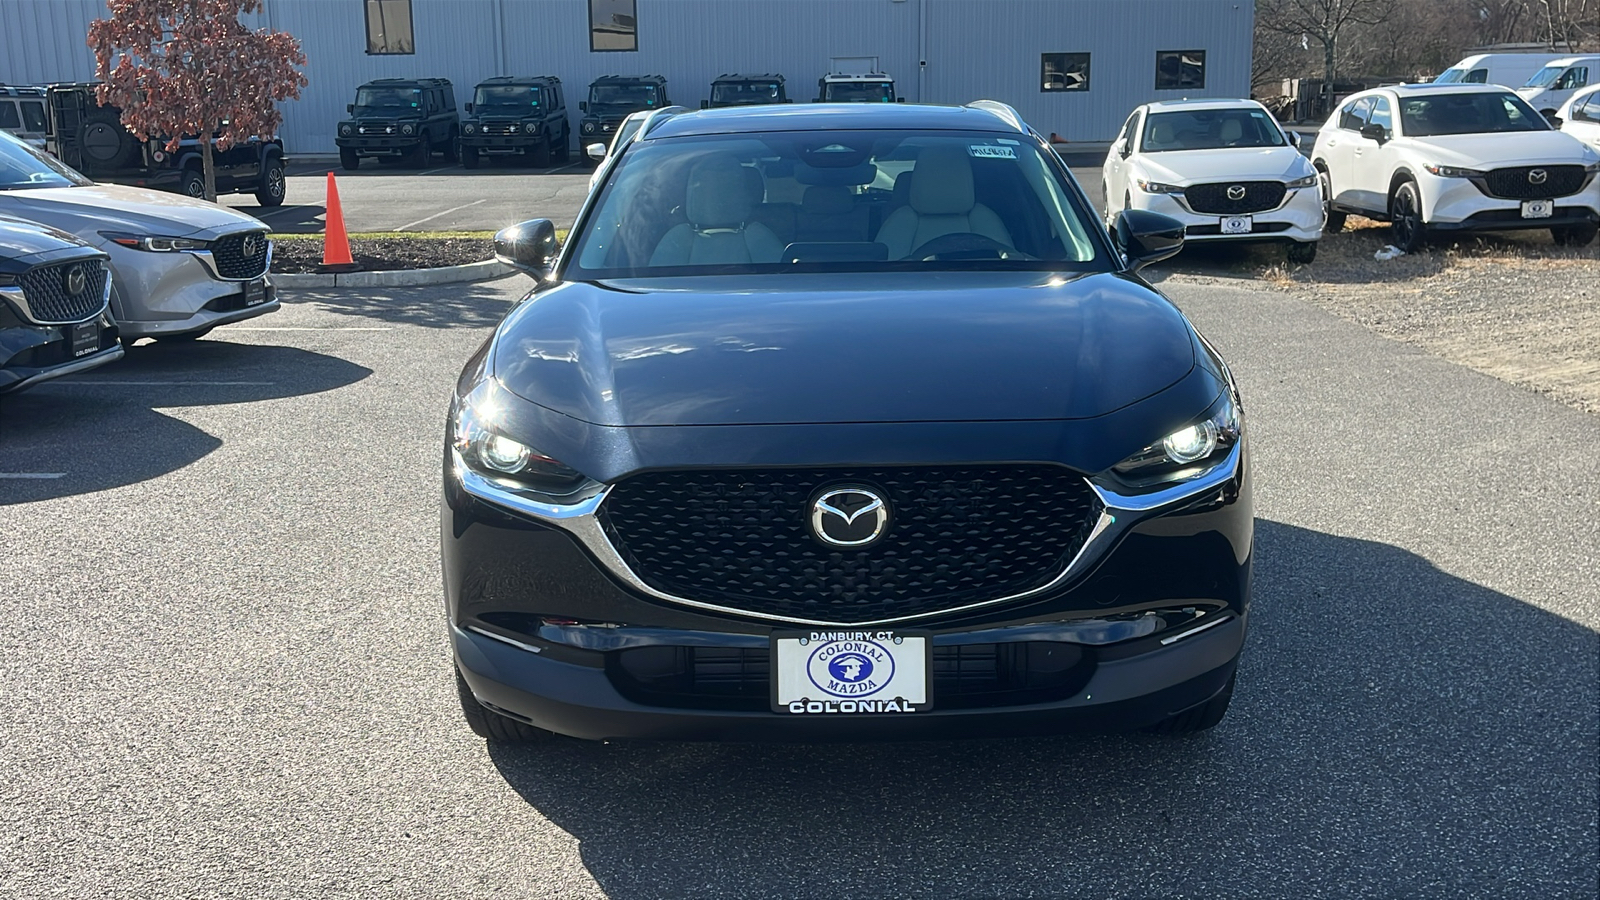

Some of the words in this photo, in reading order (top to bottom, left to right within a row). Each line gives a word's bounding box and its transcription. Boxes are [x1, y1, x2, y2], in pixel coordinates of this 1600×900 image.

[810, 631, 873, 642] DANBURY,
[876, 631, 894, 641] CT
[818, 642, 884, 663] COLONIAL
[827, 679, 877, 694] MAZDA
[789, 700, 916, 713] COLONIAL
